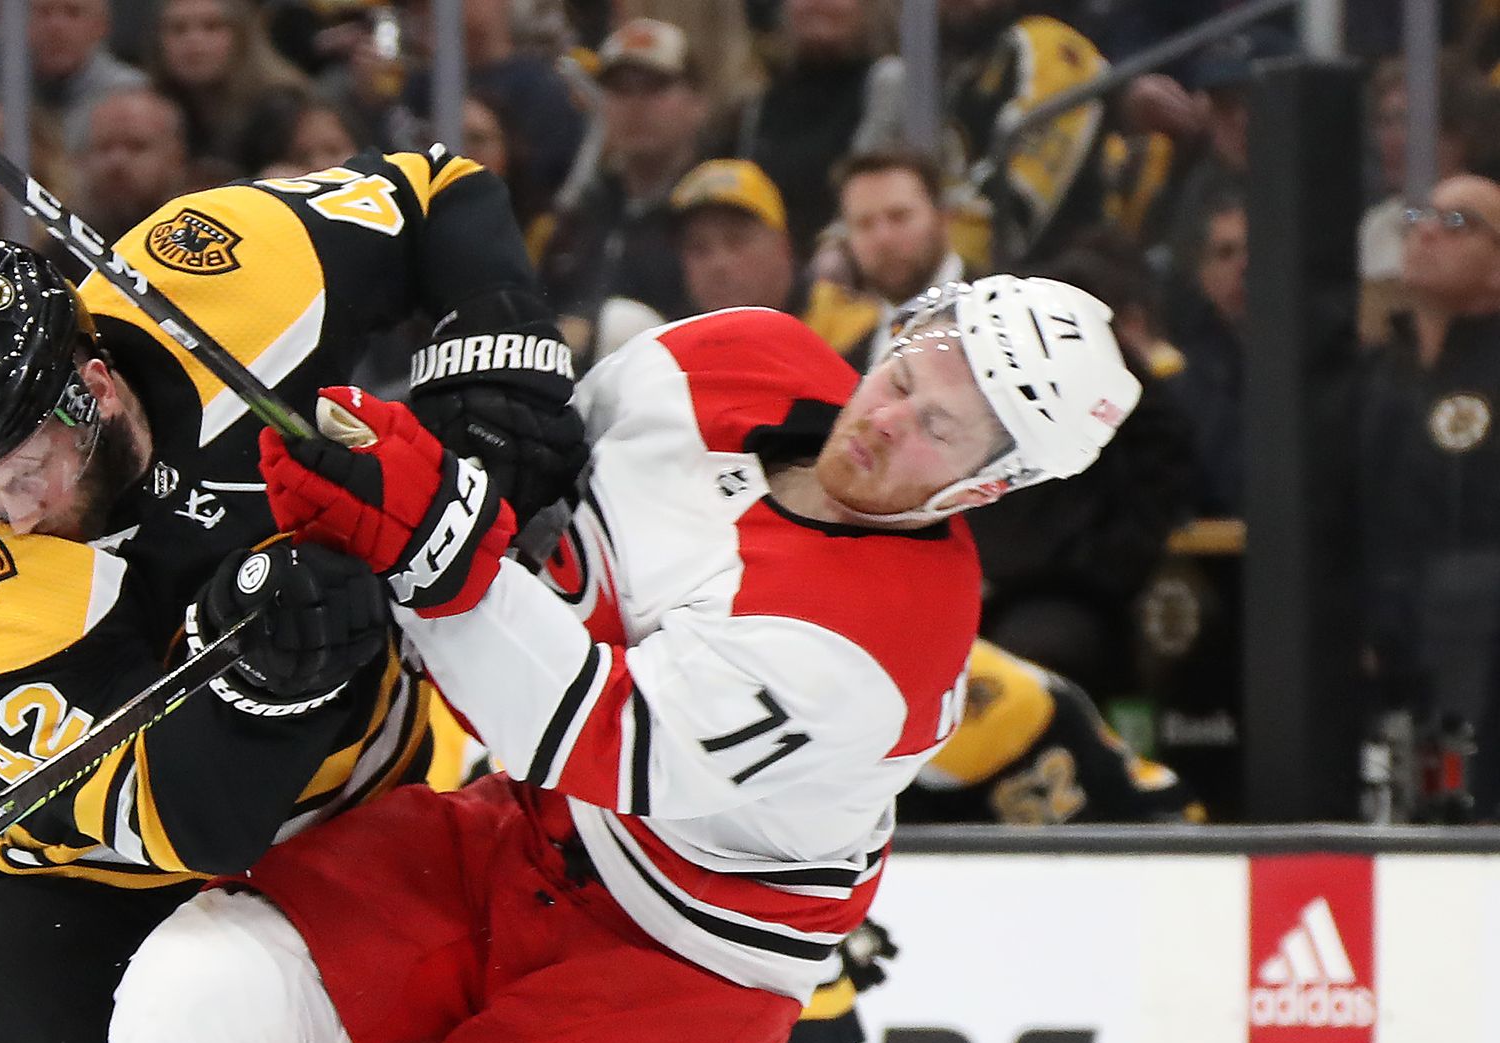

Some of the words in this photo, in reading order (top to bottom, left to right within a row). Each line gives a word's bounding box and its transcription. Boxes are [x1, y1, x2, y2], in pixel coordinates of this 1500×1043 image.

[153, 223, 226, 268] BRUINS
[410, 333, 575, 388] WARRIOR
[388, 457, 489, 604] CCM
[700, 687, 812, 786] 71
[1249, 983, 1378, 1027] adidas
